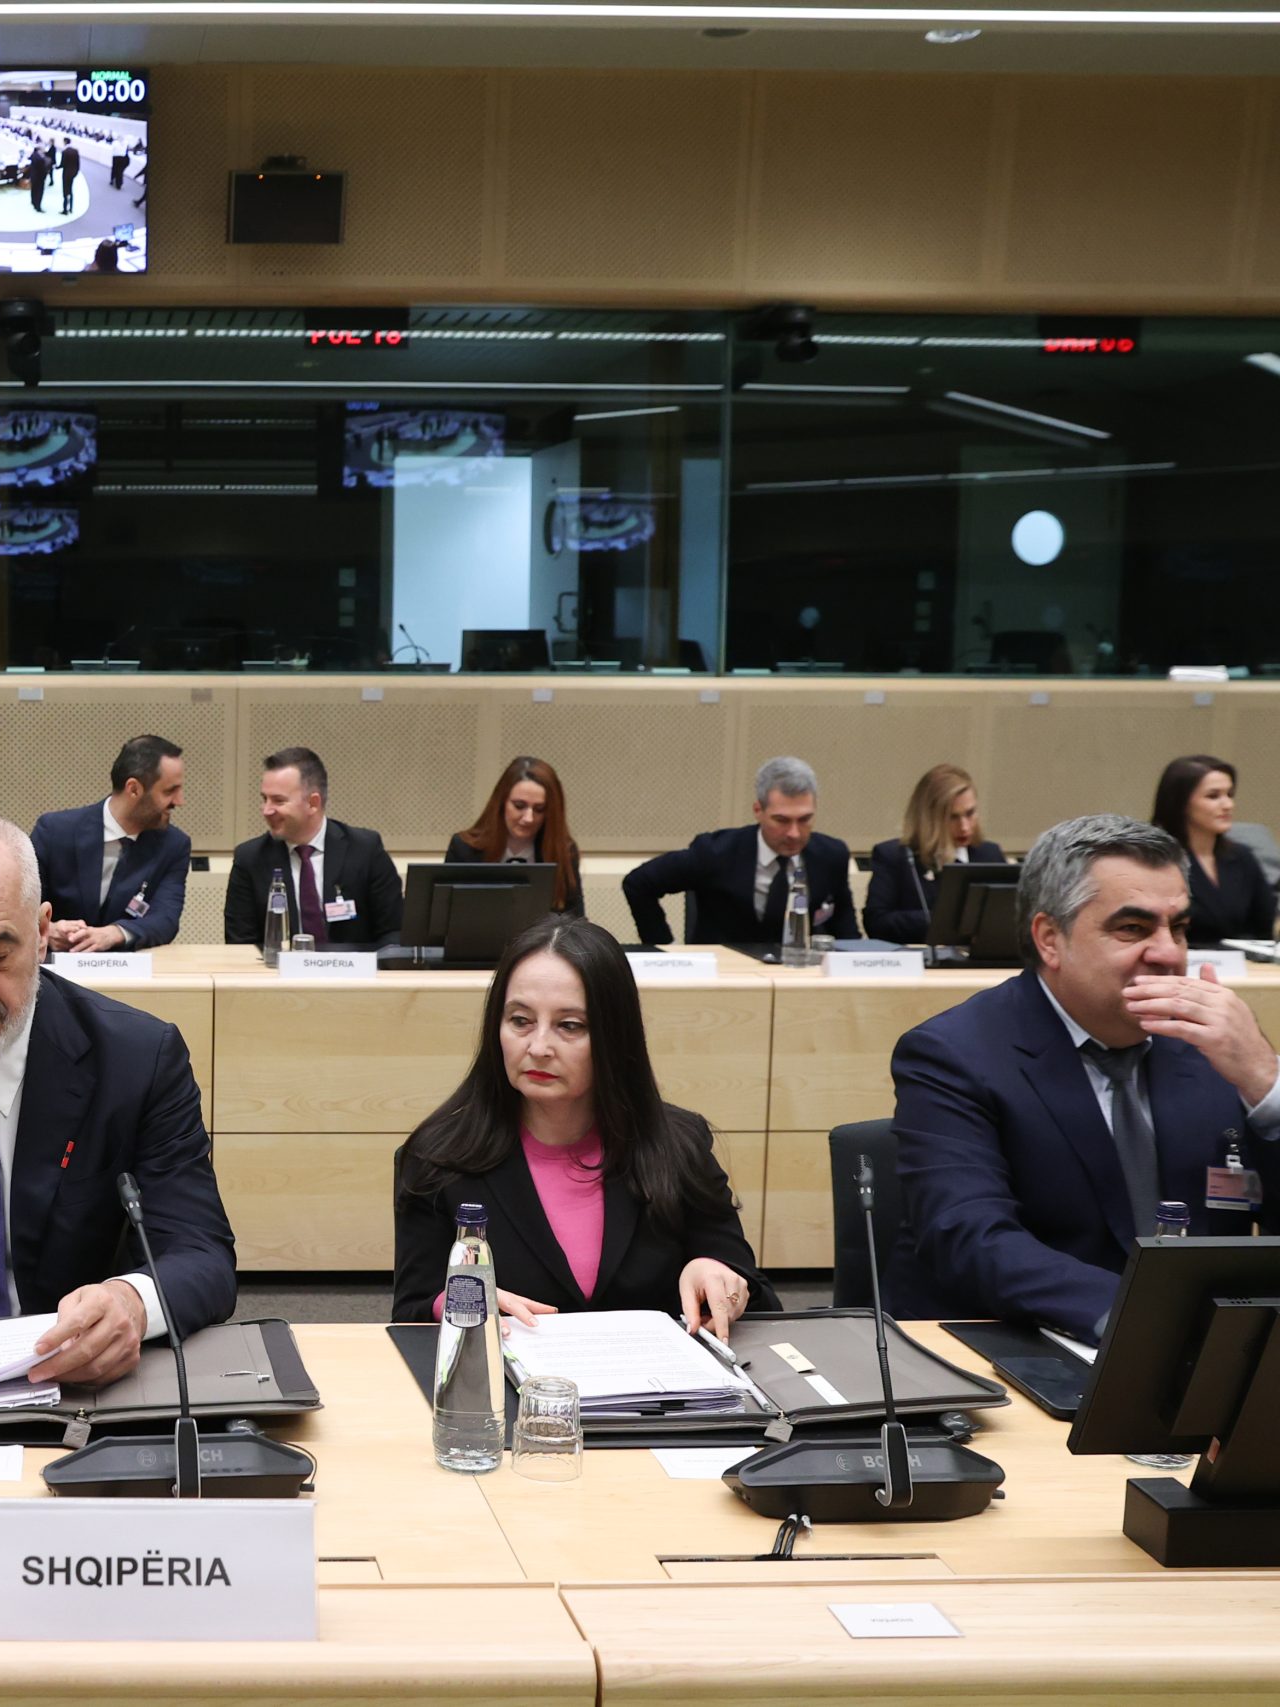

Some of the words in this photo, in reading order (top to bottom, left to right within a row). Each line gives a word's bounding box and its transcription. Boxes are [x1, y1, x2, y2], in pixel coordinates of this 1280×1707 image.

[91, 71, 132, 81] NORMAL
[77, 79, 145, 102] 00:00
[21, 1549, 232, 1589] SHQIPËRIA
